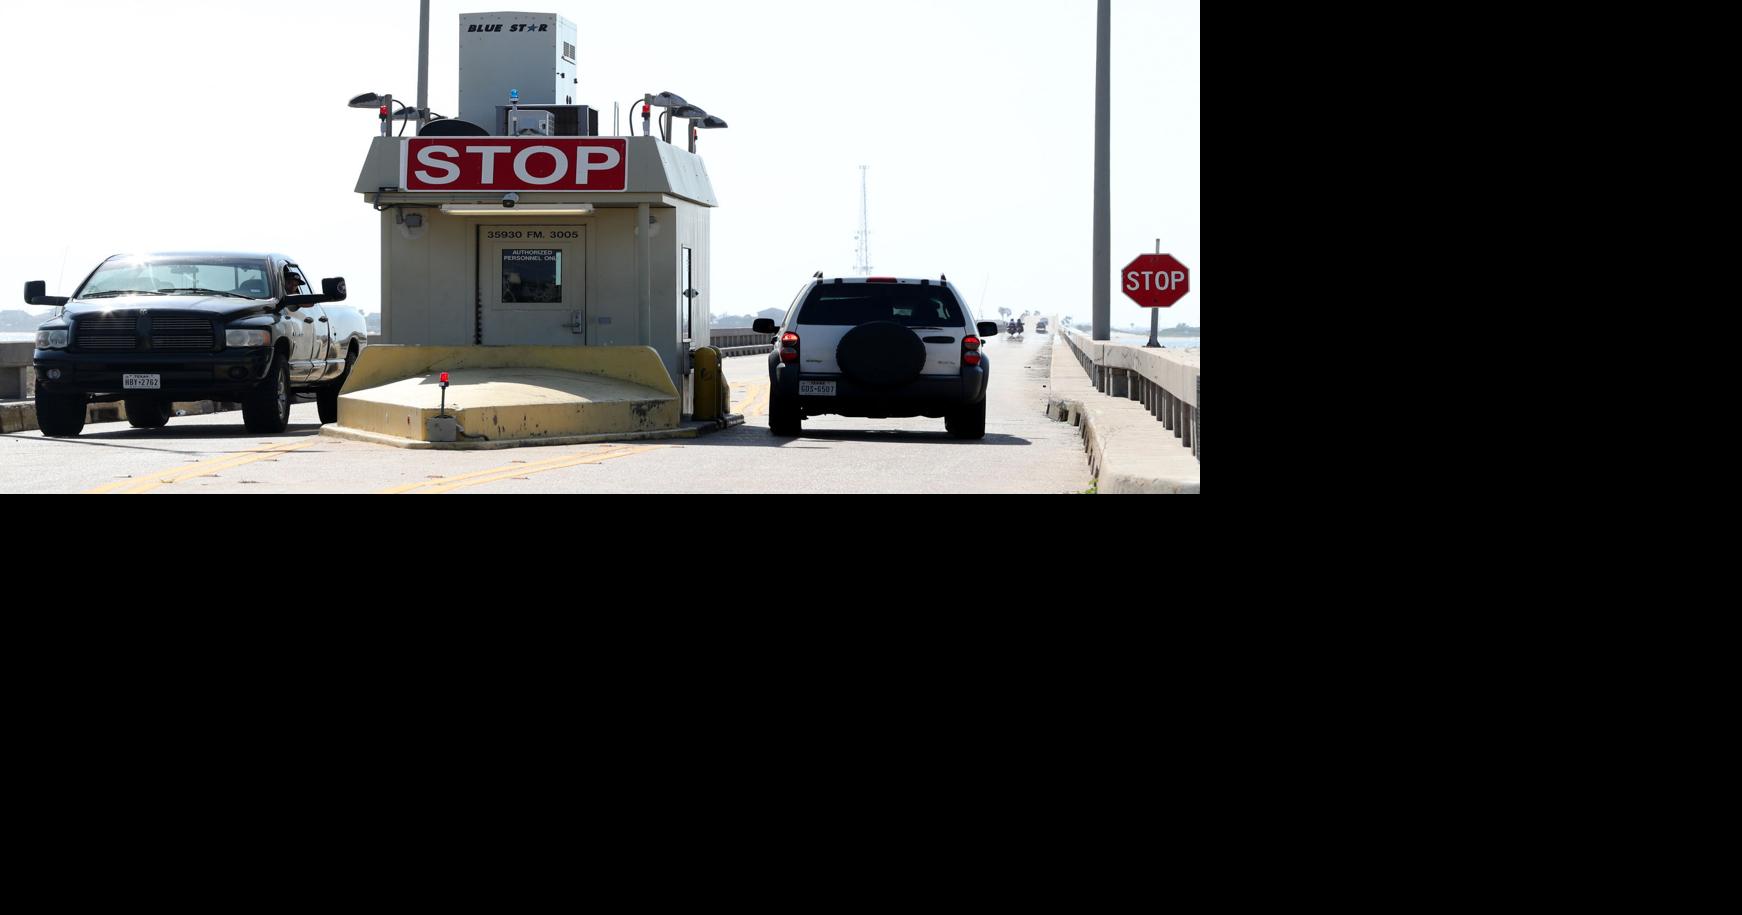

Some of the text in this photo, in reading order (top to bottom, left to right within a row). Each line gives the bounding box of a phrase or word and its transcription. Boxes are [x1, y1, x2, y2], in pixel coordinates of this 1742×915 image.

[467, 24, 503, 32] BLUE
[414, 145, 621, 185] STOP
[487, 230, 522, 238] 35930
[550, 230, 579, 238] 3005
[1126, 270, 1185, 291] STOP
